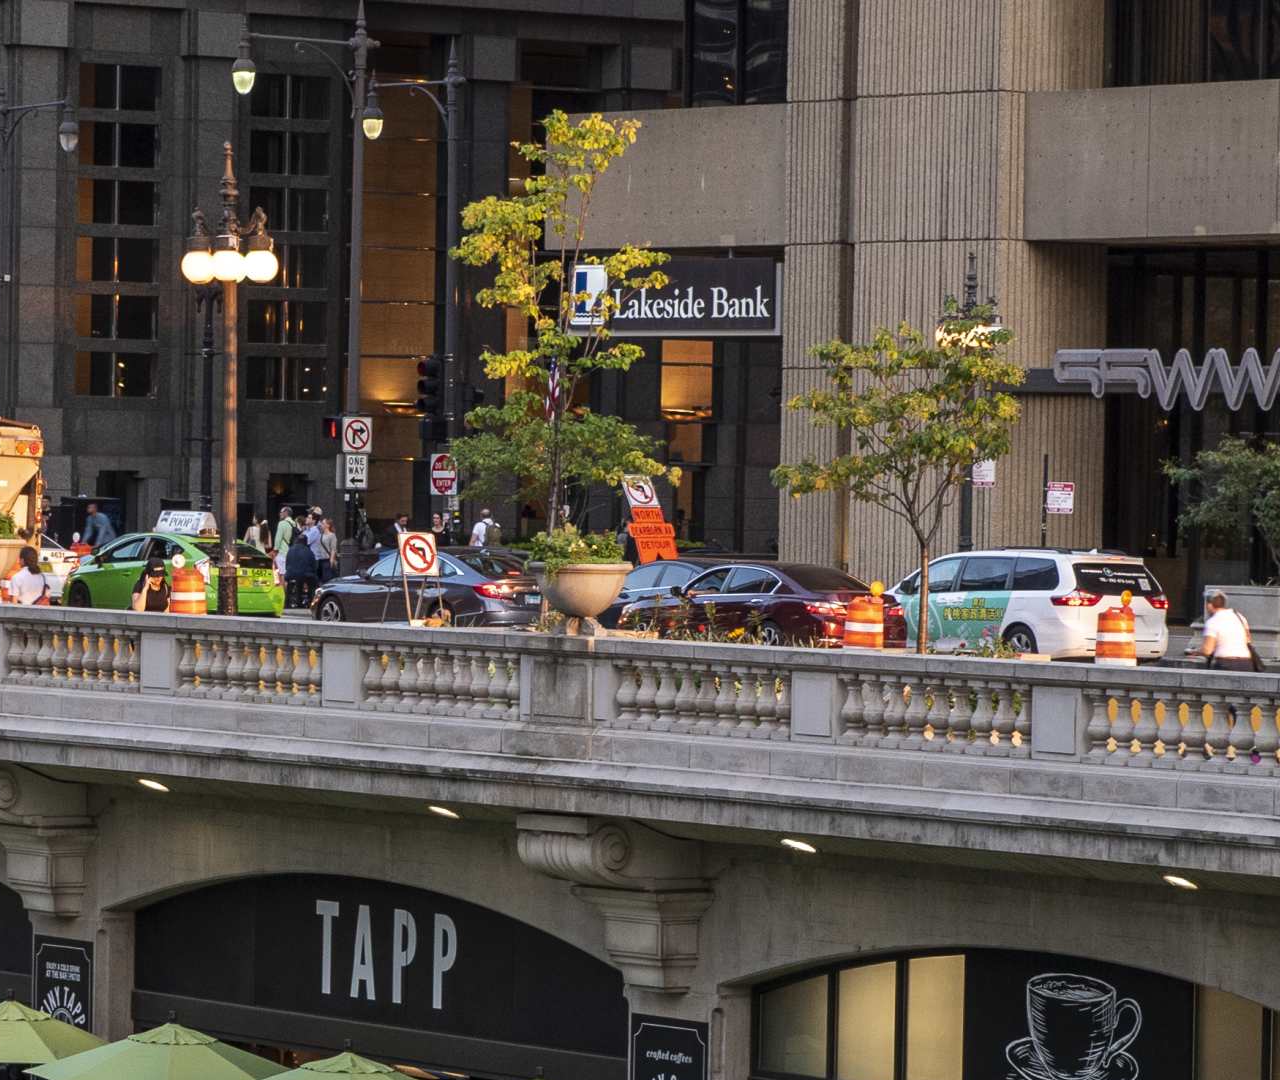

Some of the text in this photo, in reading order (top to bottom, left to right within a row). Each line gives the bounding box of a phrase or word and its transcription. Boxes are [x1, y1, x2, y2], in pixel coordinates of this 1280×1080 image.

[613, 285, 770, 319] Lakeside Bank
[348, 456, 365, 466] ONE
[348, 466, 365, 475] WAY
[435, 479, 452, 487] ENTER
[634, 510, 660, 519] NORTH
[641, 540, 671, 550] DETOUR
[316, 899, 458, 1010] TAPP
[64, 986, 86, 1024] TAPP
[646, 1050, 692, 1064] crafted coffees
